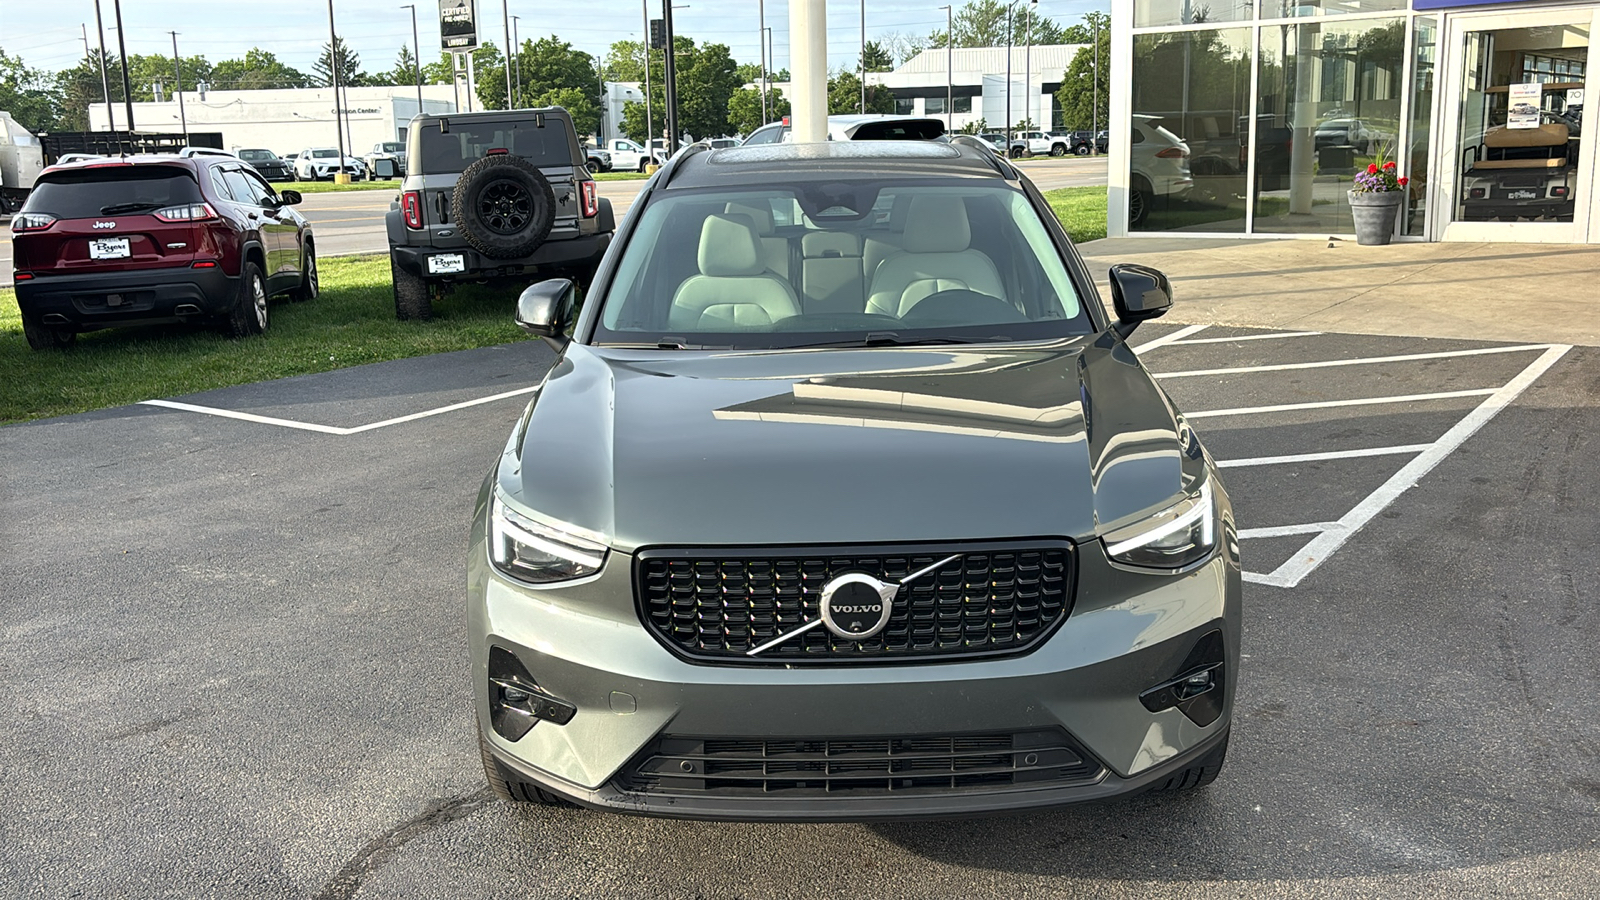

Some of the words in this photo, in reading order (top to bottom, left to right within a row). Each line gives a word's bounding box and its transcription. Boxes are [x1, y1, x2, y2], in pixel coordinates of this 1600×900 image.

[442, 6, 470, 16] CERTIFIED
[447, 38, 468, 47] LINDSAY
[92, 221, 116, 229] Jeep
[93, 243, 126, 253] Byers
[831, 604, 882, 613] VOLVO
